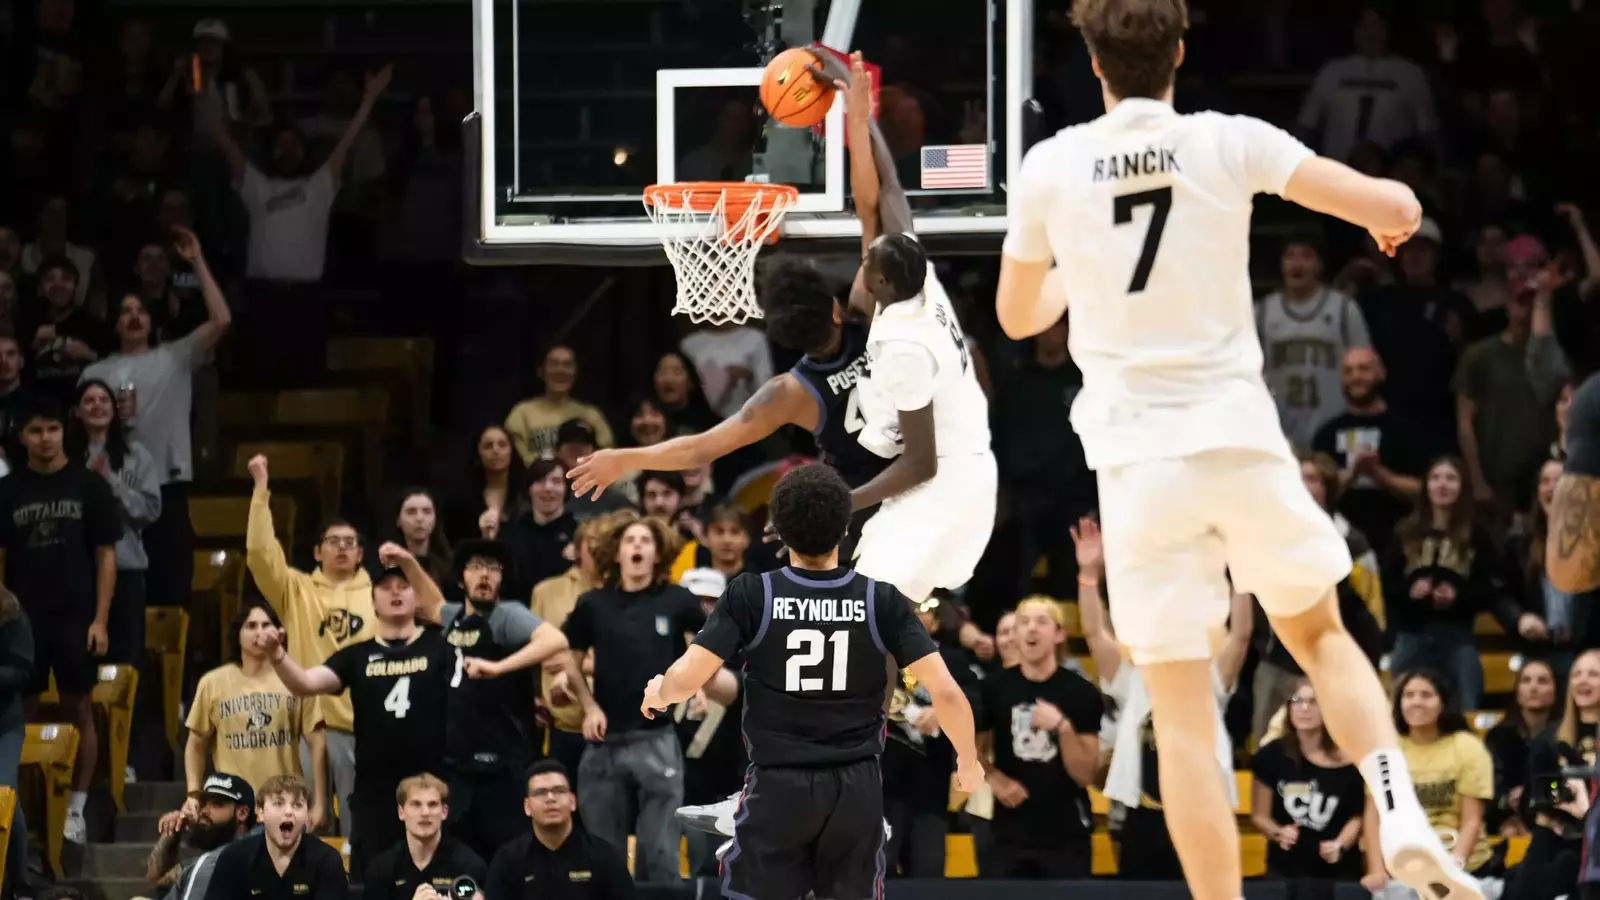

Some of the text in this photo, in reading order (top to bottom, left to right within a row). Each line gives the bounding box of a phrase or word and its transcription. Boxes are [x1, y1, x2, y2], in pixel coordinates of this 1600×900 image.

[1092, 144, 1182, 183] RANČIK
[1113, 185, 1173, 294] 7
[772, 597, 866, 623] REYNOLDS
[365, 655, 429, 678] COLORADO
[785, 629, 850, 692] 21
[219, 692, 281, 719] UNIVERSITY
[384, 675, 411, 719] 4
[226, 730, 293, 750] COLORADO
[1283, 791, 1341, 824] CU
